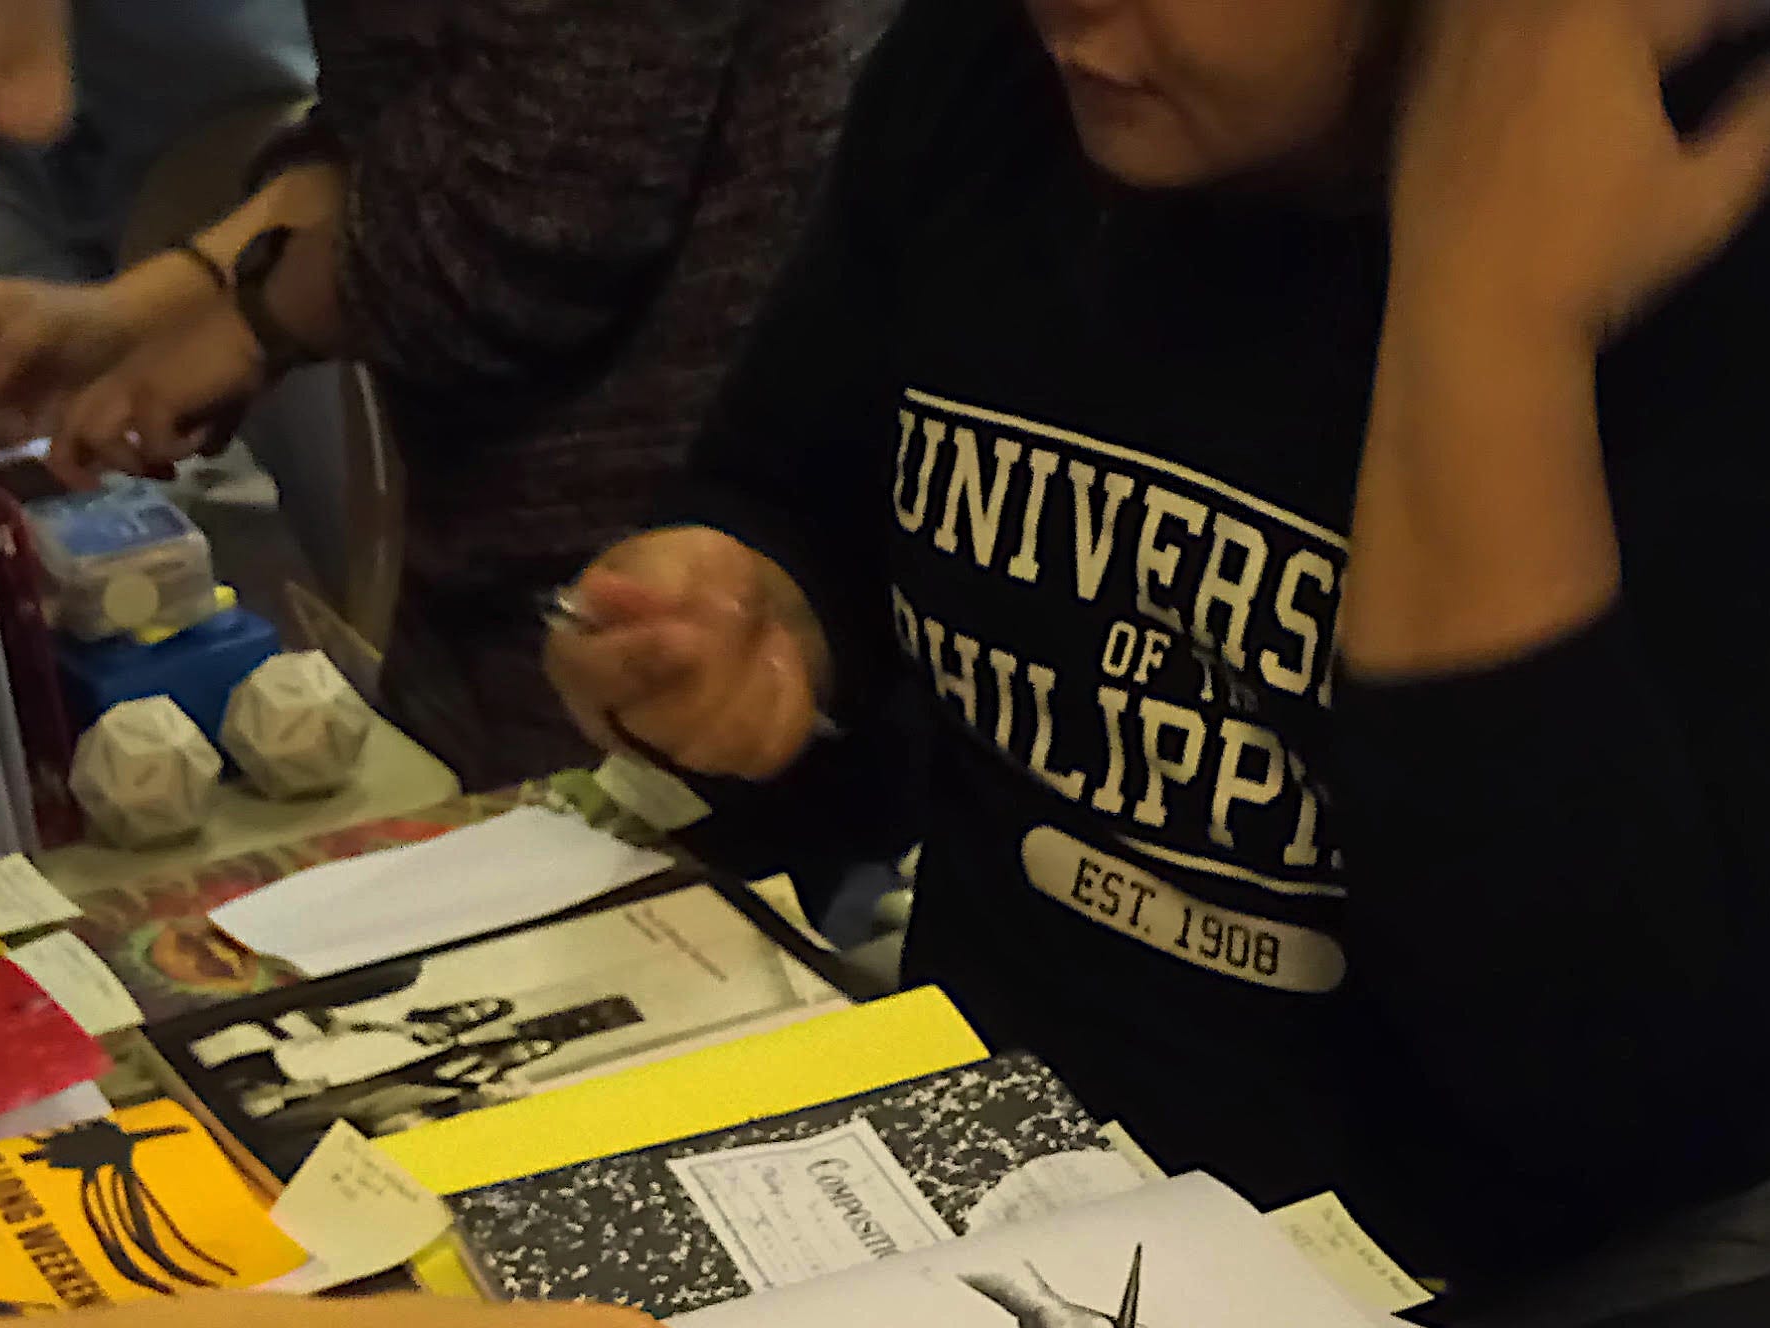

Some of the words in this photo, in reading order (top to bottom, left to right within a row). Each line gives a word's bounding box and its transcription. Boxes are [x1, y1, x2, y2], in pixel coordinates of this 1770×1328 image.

[891, 408, 1335, 708] UNIVERS
[1101, 619, 1172, 685] OF
[890, 582, 1344, 869] PHILIPPI
[1070, 855, 1153, 934] EST.
[1174, 905, 1280, 977] 1908
